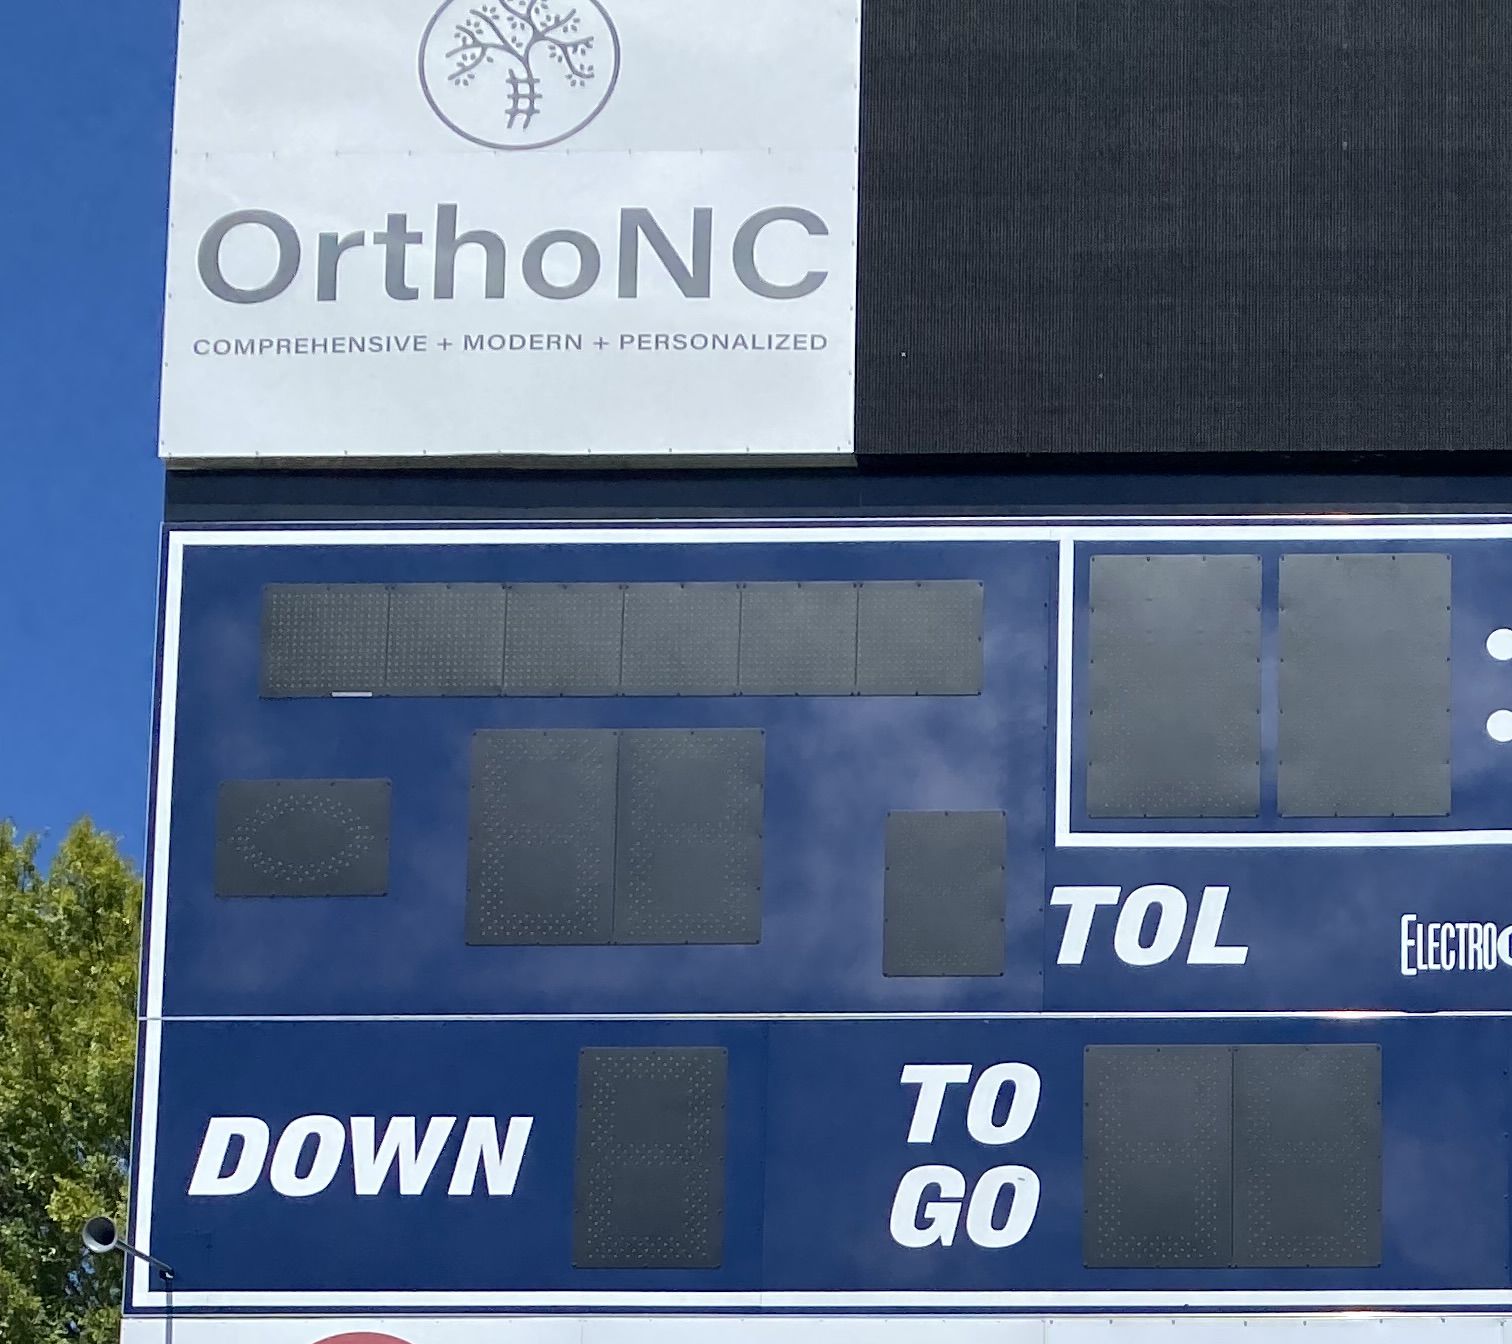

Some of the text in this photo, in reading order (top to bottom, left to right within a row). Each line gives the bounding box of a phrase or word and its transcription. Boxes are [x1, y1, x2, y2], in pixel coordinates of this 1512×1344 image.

[197, 203, 829, 304] OrthoNC
[193, 335, 428, 356] COMPREHENSIVE
[463, 333, 584, 351] MODERN
[619, 333, 828, 351] PERSONALIZED
[1049, 886, 1249, 966] TOL
[899, 1062, 1042, 1146] TO
[187, 1115, 533, 1197] DOWN
[889, 1164, 1041, 1249] GO
